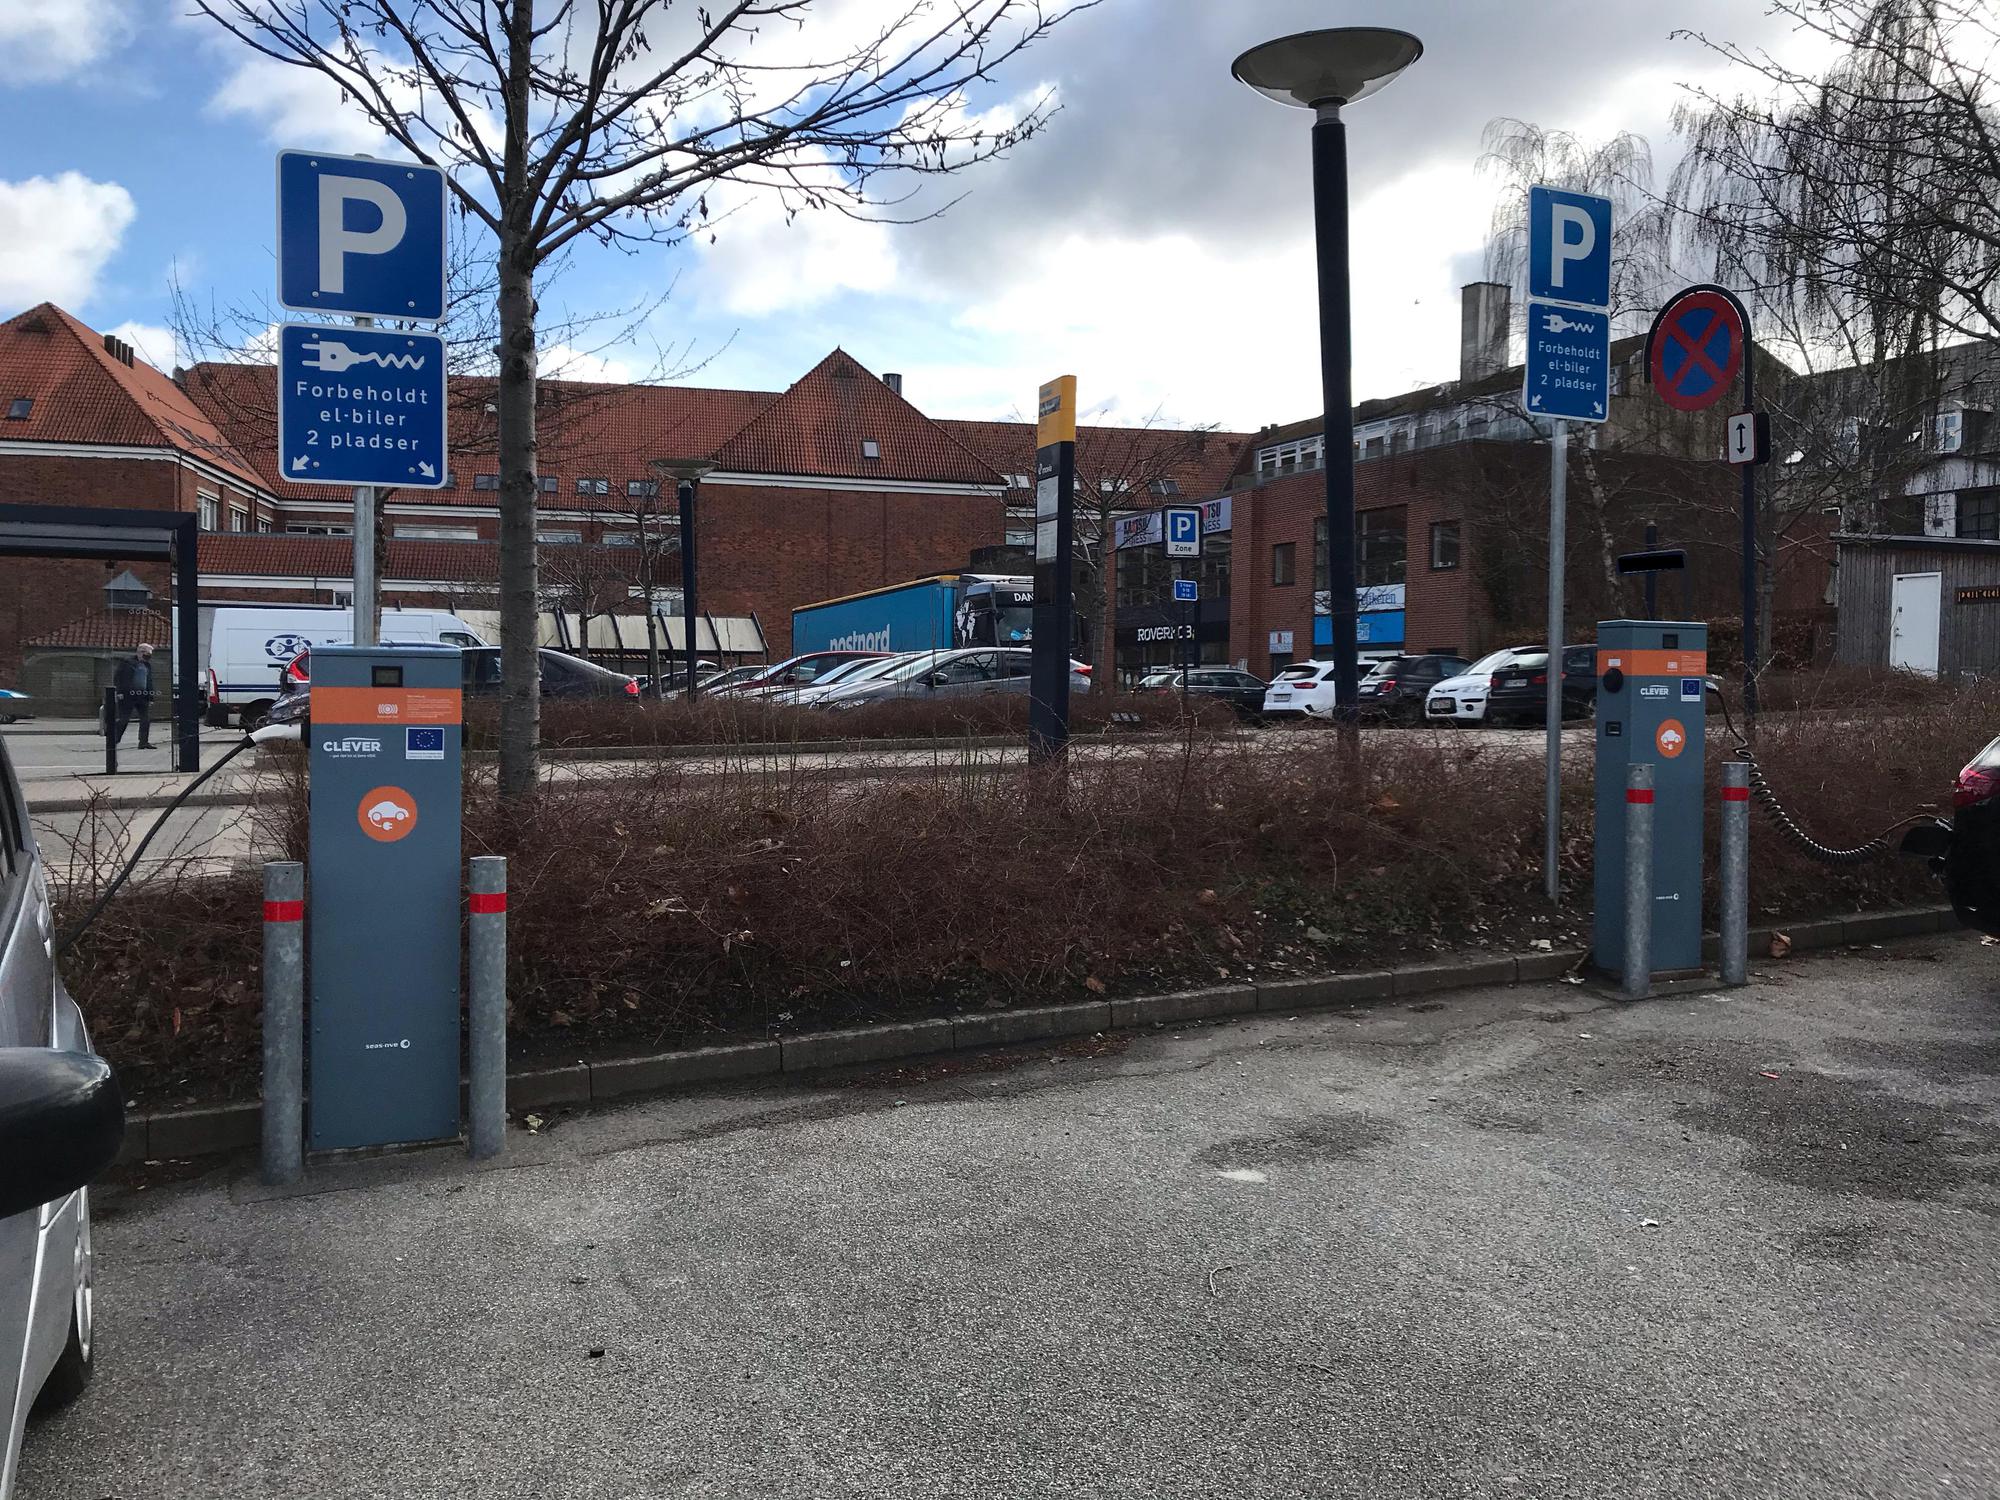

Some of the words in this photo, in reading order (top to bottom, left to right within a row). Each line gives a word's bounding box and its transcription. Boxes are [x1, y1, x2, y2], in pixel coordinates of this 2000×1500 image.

[319, 174, 407, 294] P
[1551, 203, 1596, 288] P
[1538, 341, 1601, 360] Forbeholdt
[1548, 360, 1591, 374] el-biler
[1541, 374, 1548, 385] 2
[1555, 377, 1597, 391] pladser
[296, 381, 428, 404] Forbeholdt
[320, 408, 406, 426] el-biler
[306, 430, 319, 445] 2
[331, 433, 419, 450] pladser
[1202, 501, 1222, 520] ATSU
[1177, 516, 1192, 539] P
[1203, 520, 1221, 533] NESS
[1174, 545, 1193, 553] Zone
[829, 623, 891, 652] postnord
[1639, 687, 1670, 696] CLEVER
[322, 741, 382, 752] CLEVER
